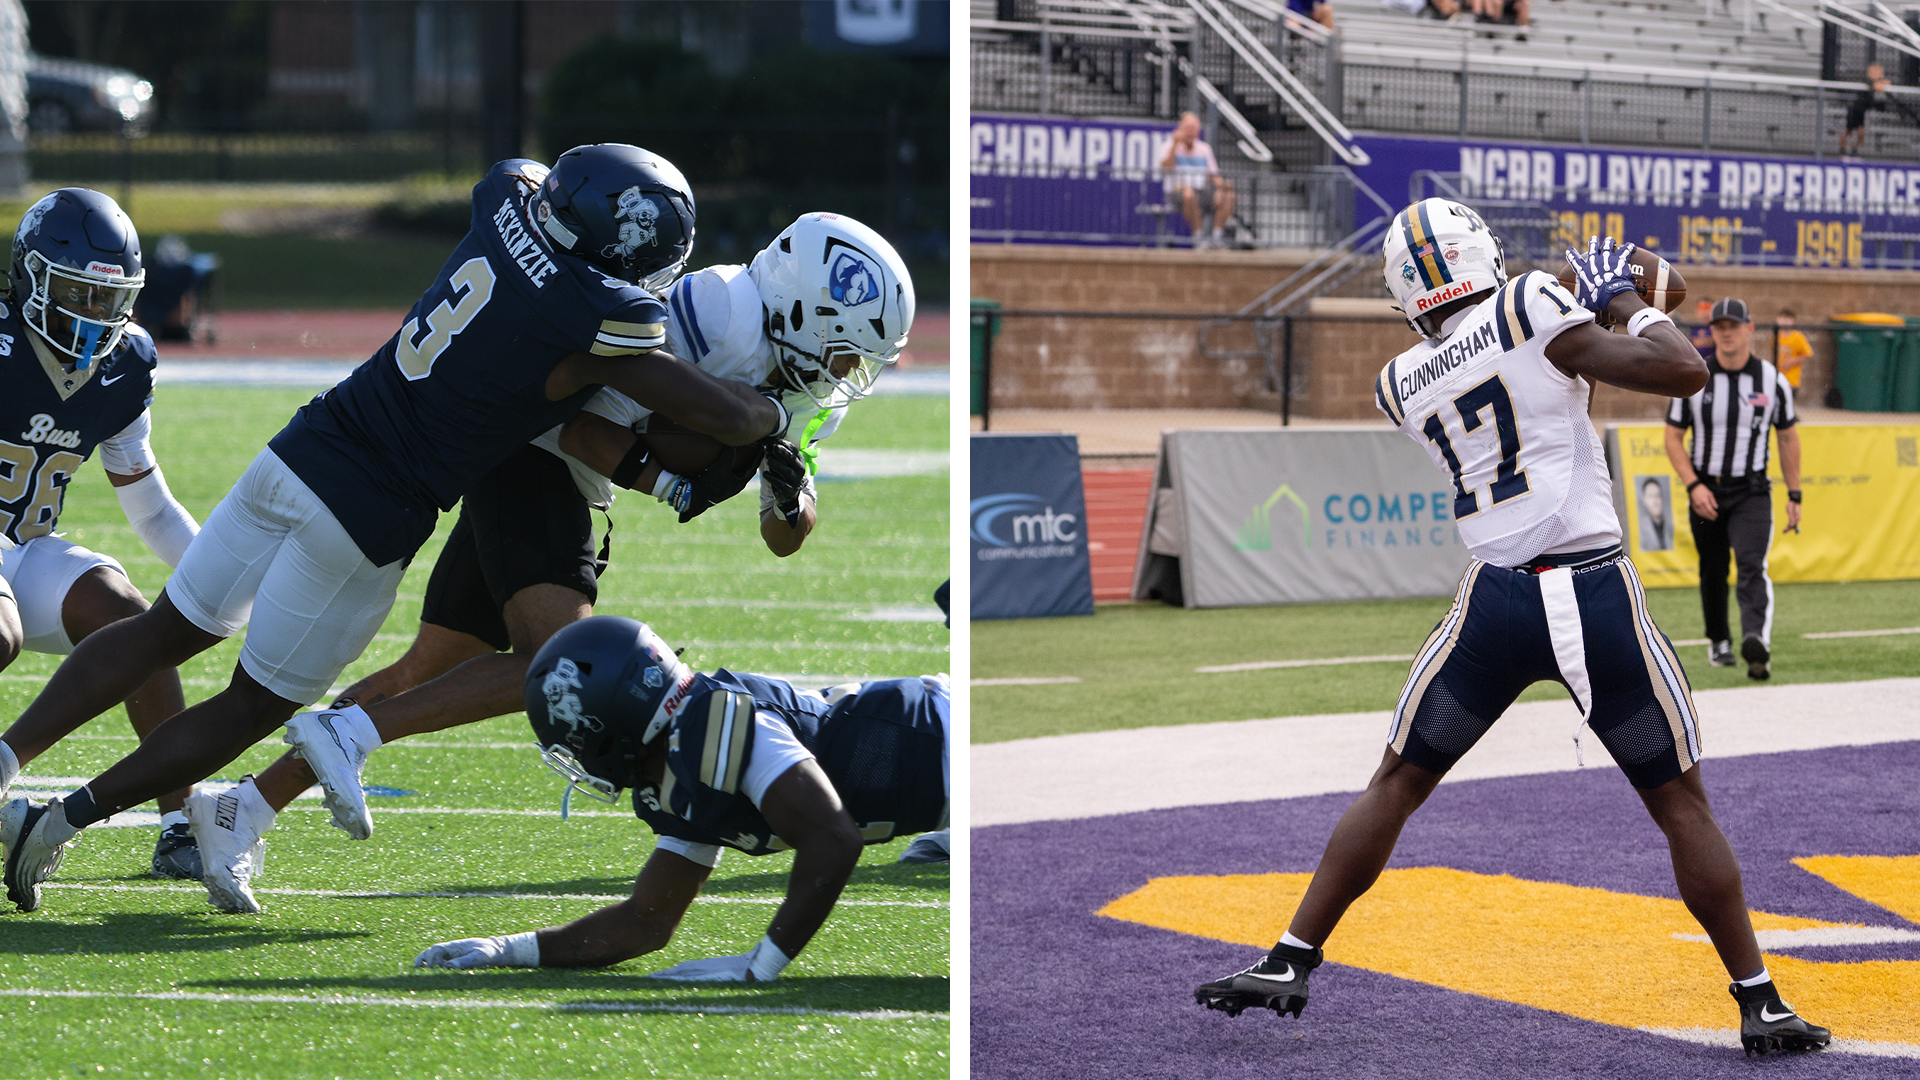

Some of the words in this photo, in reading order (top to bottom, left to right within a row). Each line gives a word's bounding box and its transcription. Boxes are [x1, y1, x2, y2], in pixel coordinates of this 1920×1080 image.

[1459, 147, 1556, 200] NCAA
[1564, 153, 1712, 208] PLAYOFF
[493, 197, 559, 289] MCKINZIE
[1416, 280, 1474, 312] Riddell
[395, 256, 497, 381] 3
[1400, 321, 1497, 402] CUNNINGHAM
[21, 413, 81, 449] Bucs
[1421, 370, 1534, 521] 17
[1012, 505, 1078, 544] mtc
[1323, 492, 1455, 524] COMPE
[977, 544, 1076, 561] communications
[216, 794, 237, 831] NIKE
